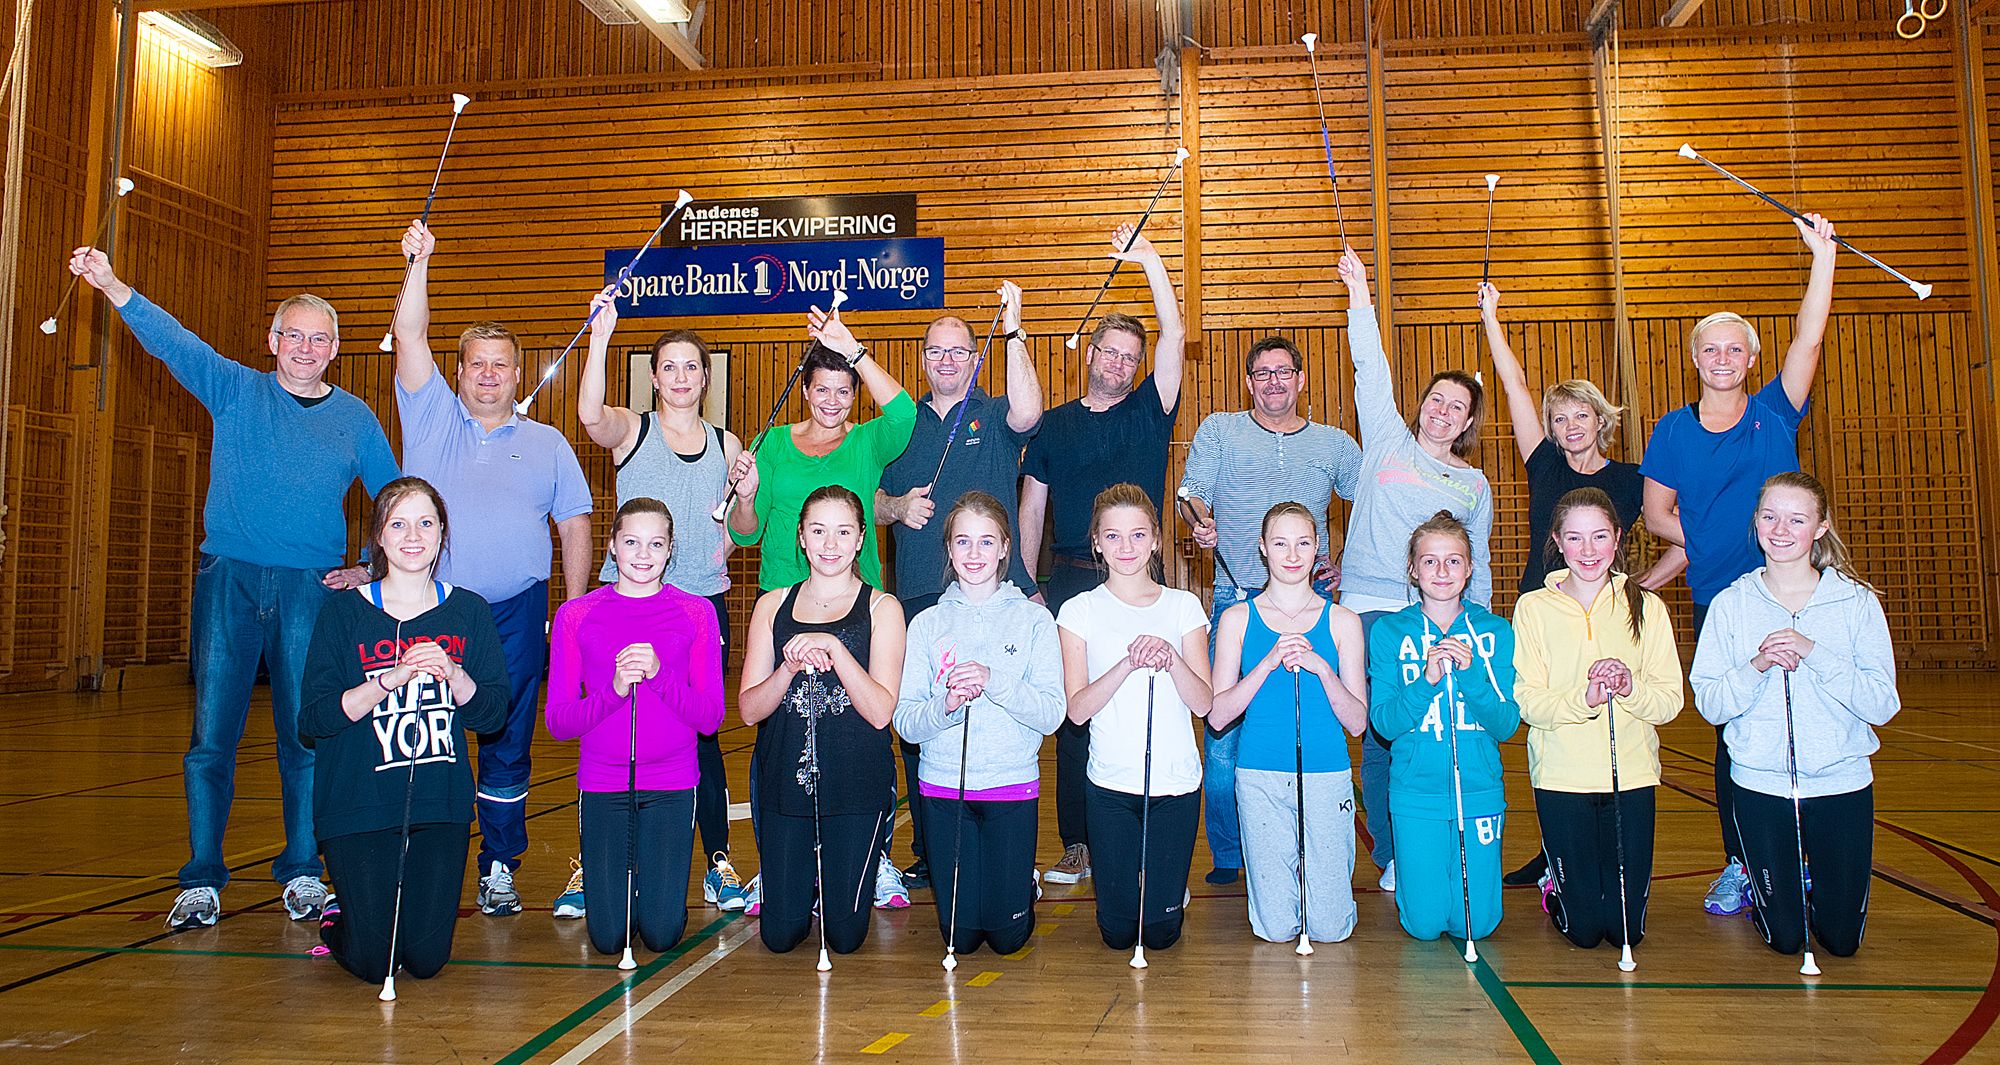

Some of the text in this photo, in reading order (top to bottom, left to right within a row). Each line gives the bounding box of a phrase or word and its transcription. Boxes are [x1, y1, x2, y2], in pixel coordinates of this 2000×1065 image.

[680, 213, 897, 241] HERREEKVIPERING
[681, 205, 760, 221] Andenes
[618, 257, 930, 307] SpareBank 1 Nord-Norge
[358, 634, 467, 664] LONON
